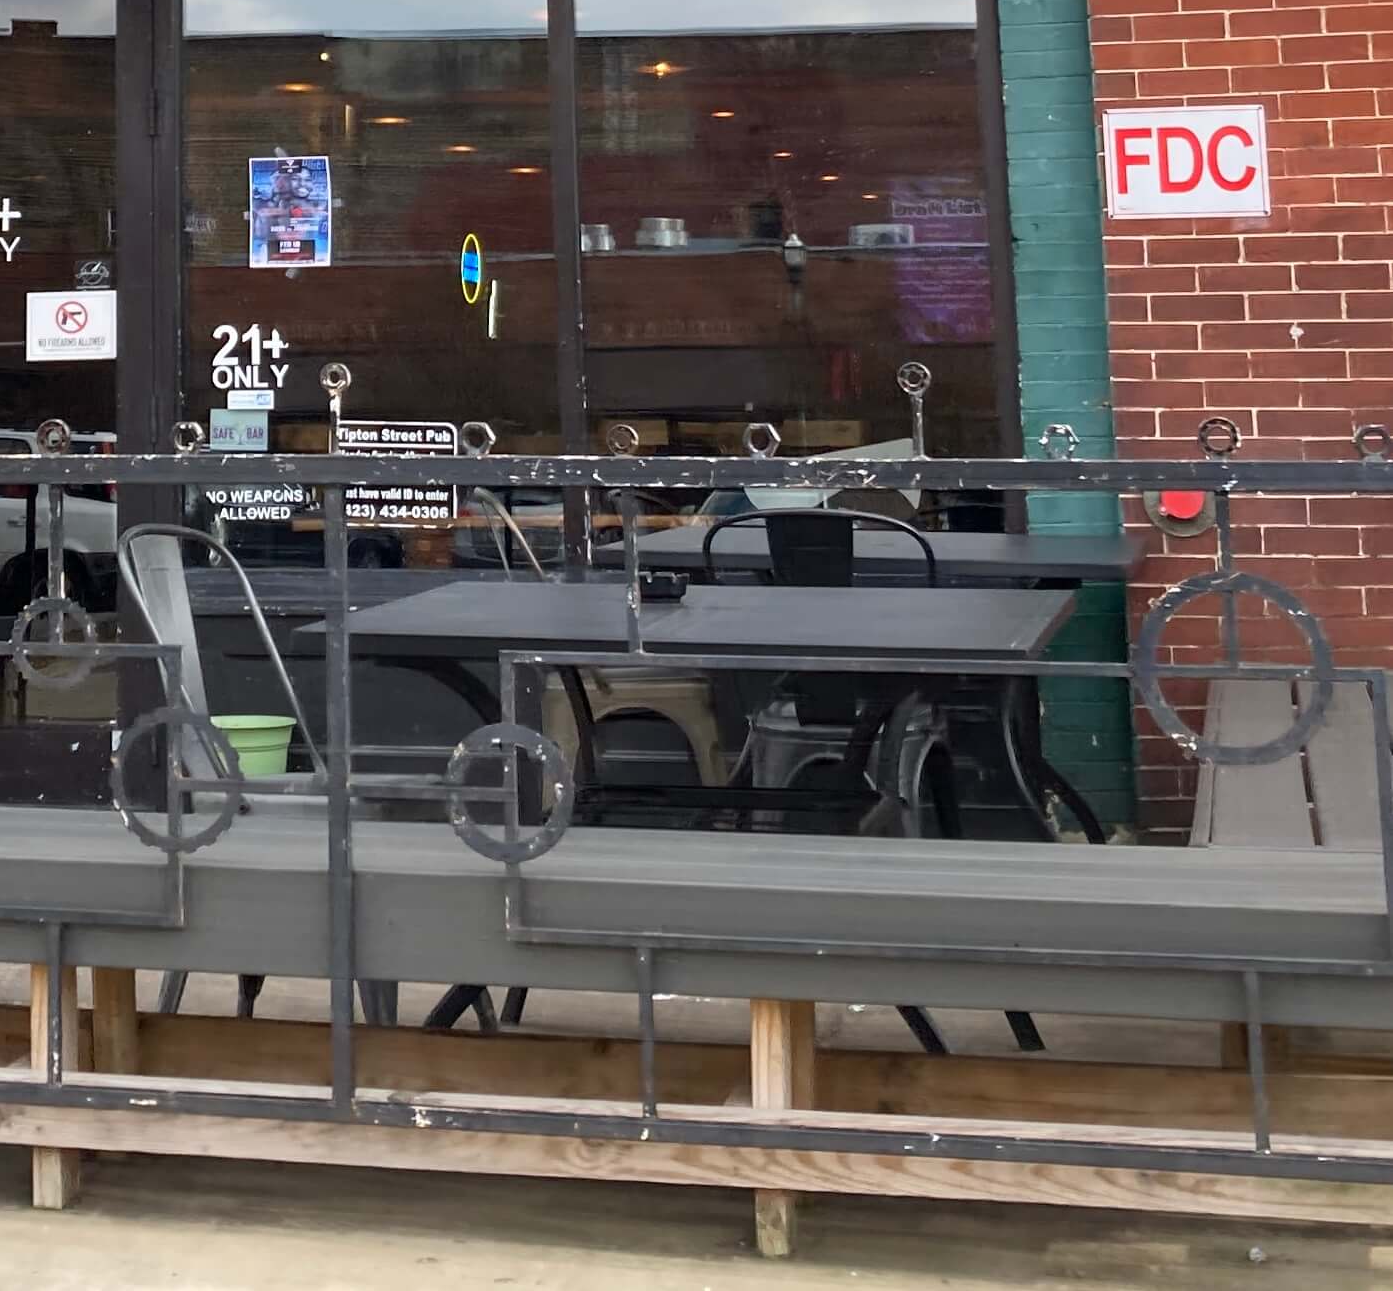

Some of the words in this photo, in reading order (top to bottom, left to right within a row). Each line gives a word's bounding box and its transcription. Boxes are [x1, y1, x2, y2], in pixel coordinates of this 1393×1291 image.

[1114, 125, 1257, 194] FDC
[78, 336, 106, 347] ALLOWED
[211, 323, 289, 366] 21+
[211, 364, 289, 389] ONLY
[213, 427, 235, 439] SAFE
[246, 427, 264, 439] BAR
[338, 428, 378, 443] Tipton
[381, 428, 423, 442] Street
[426, 429, 452, 442] Pub
[206, 490, 227, 504] NO
[230, 489, 304, 504] WEAPONS
[358, 487, 379, 499] have
[380, 487, 402, 500] valid
[403, 488, 414, 500] ID
[414, 489, 424, 501] to
[426, 489, 449, 501] enter
[220, 507, 291, 521] ALLOWED
[379, 505, 449, 519] 434-0306
